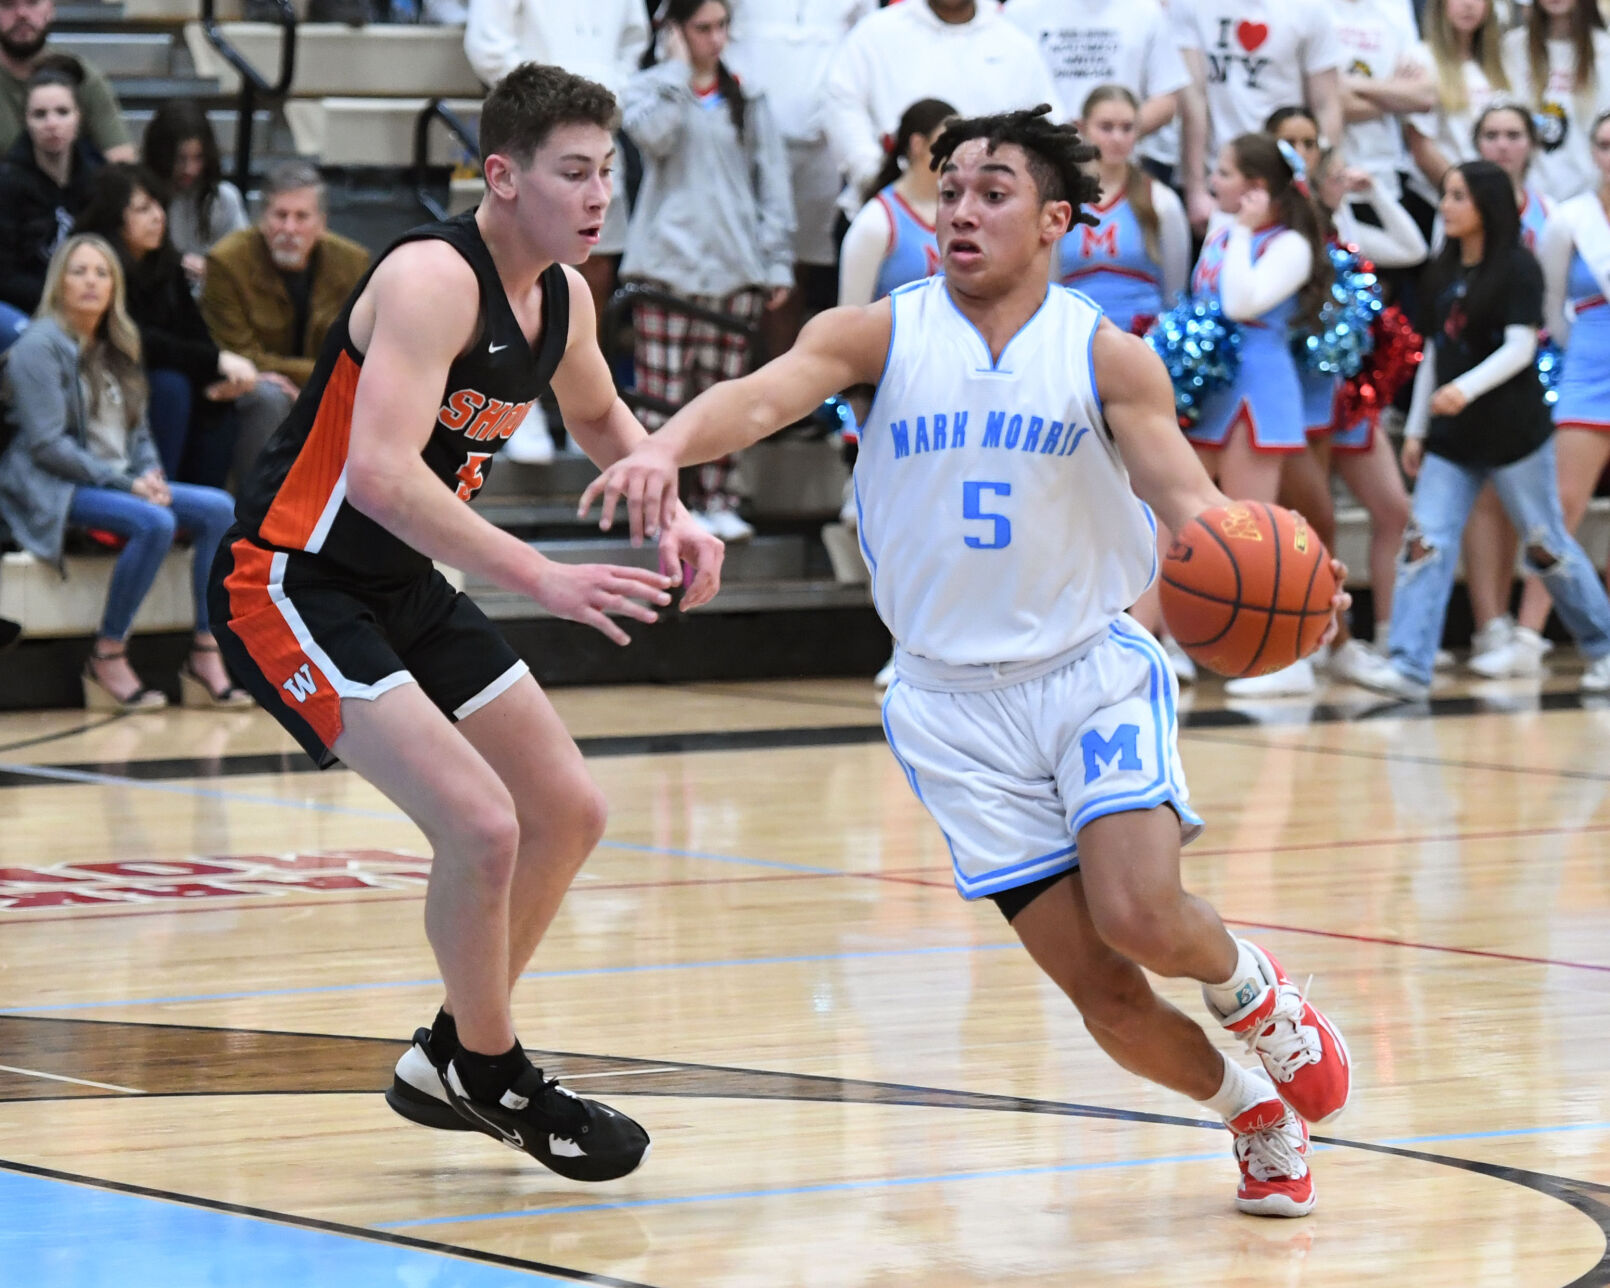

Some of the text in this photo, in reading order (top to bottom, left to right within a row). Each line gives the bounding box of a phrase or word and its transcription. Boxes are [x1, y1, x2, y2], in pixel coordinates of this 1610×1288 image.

[1217, 18, 1232, 48] I
[1207, 53, 1271, 88] NY
[1080, 222, 1118, 258] M
[889, 410, 1090, 459] MARK MORRIS
[962, 480, 1012, 550] 5
[282, 663, 318, 704] W
[1081, 723, 1143, 786] M
